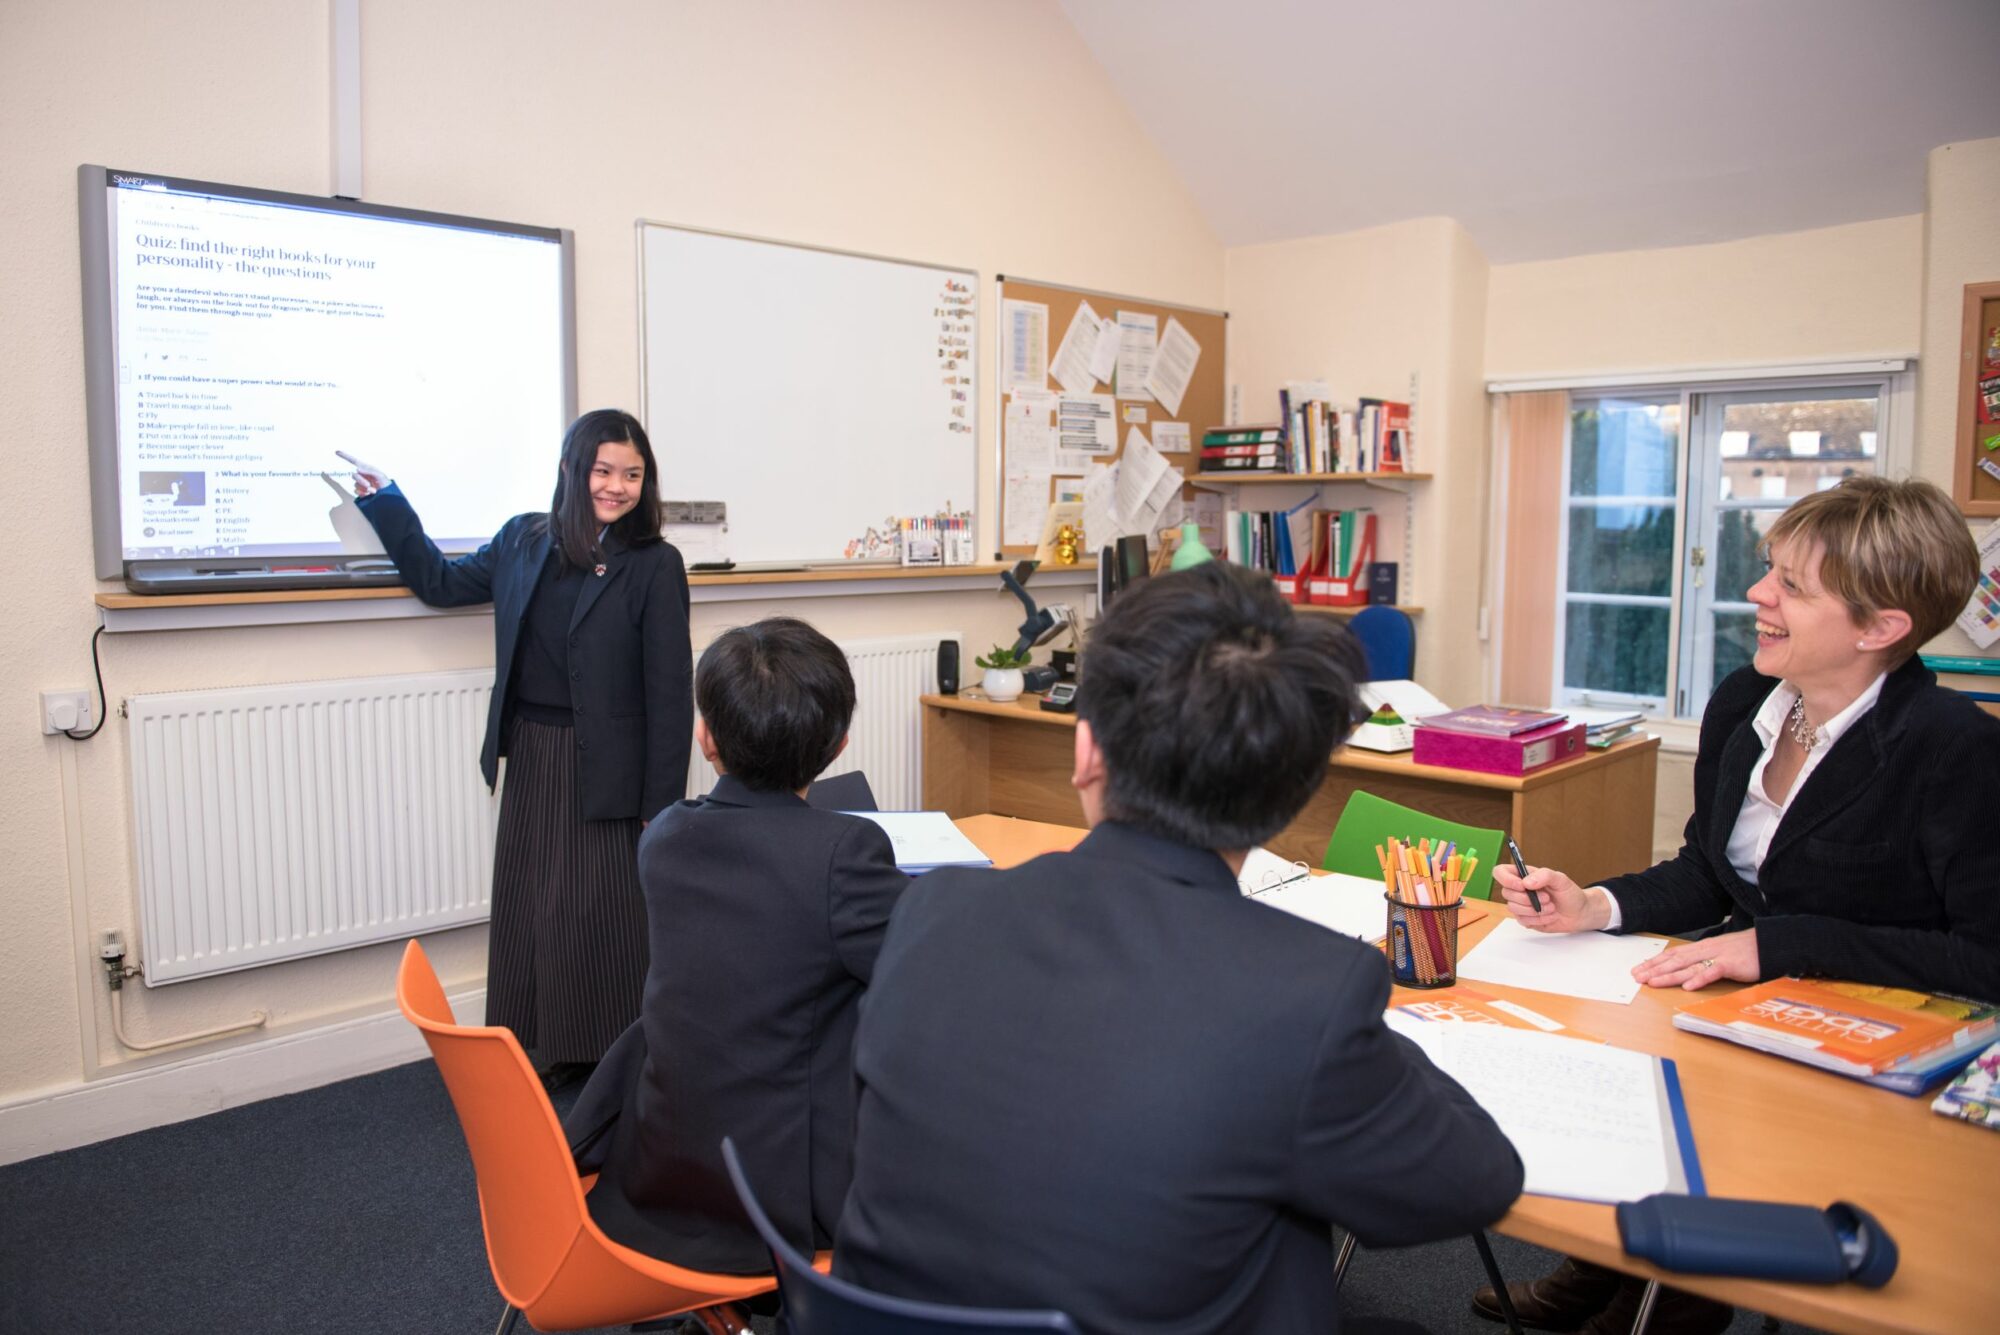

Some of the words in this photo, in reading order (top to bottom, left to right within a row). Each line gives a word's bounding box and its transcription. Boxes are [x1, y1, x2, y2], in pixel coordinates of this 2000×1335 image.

[114, 175, 144, 185] SMART
[136, 233, 177, 250] Quiz:
[181, 238, 210, 253] find
[214, 242, 238, 256] the
[242, 244, 275, 261] right
[280, 248, 321, 264] books
[325, 253, 343, 266] for
[347, 258, 376, 270] your
[137, 253, 224, 273] personality
[236, 260, 260, 273] the
[263, 265, 332, 281] questions
[175, 287, 211, 296] daredevil
[137, 294, 162, 302] laugh,
[174, 297, 200, 305] always
[211, 308, 241, 317] through
[257, 311, 272, 319] quiz
[182, 403, 211, 411] magical
[224, 517, 251, 525] English
[1739, 1006, 1873, 1044] CUTTING
[1753, 999, 1897, 1040] EDGE
